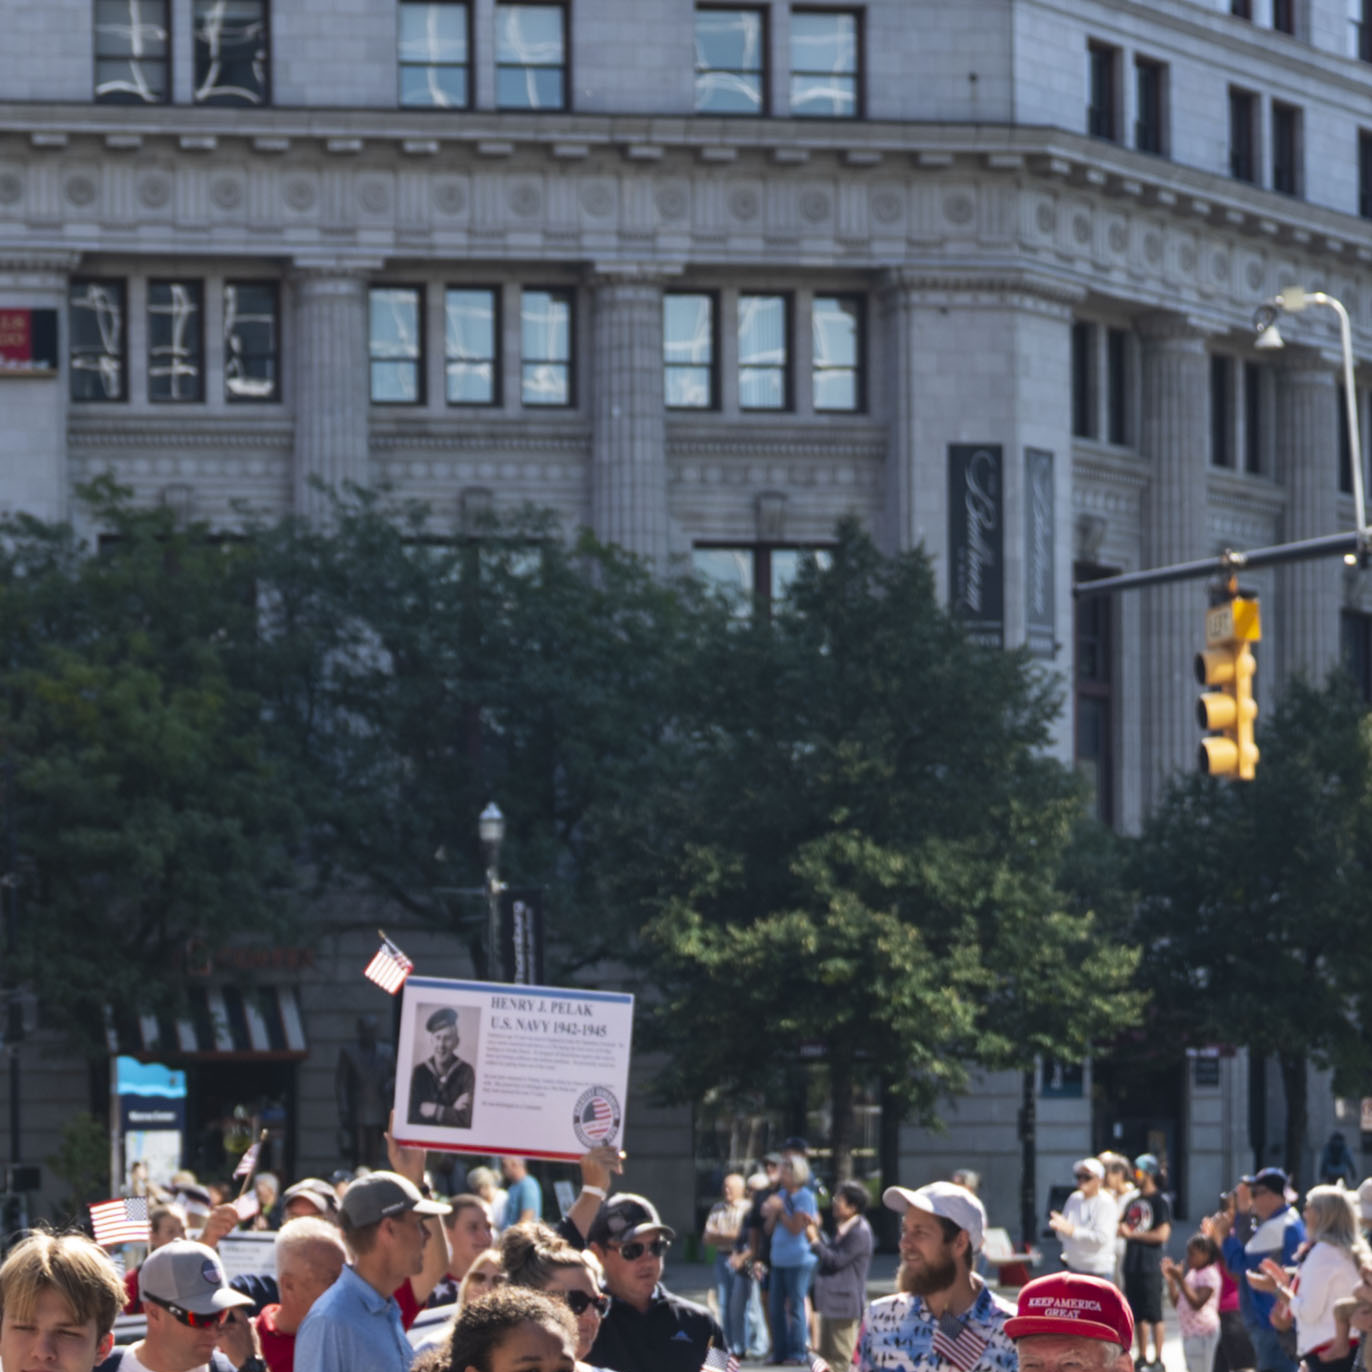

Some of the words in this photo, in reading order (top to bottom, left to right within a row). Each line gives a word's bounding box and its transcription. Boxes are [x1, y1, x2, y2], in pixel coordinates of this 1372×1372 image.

[491, 996, 533, 1012] HENRY
[538, 1000, 546, 1013] J.
[551, 1001, 592, 1017] PELAK
[491, 1016, 512, 1030] U.S.
[517, 1018, 549, 1033] NAVY
[554, 1022, 607, 1037] 1942-1945
[1028, 1297, 1054, 1308] KEEP
[1055, 1299, 1102, 1312] AMERICA
[1044, 1308, 1081, 1318] GREAT
